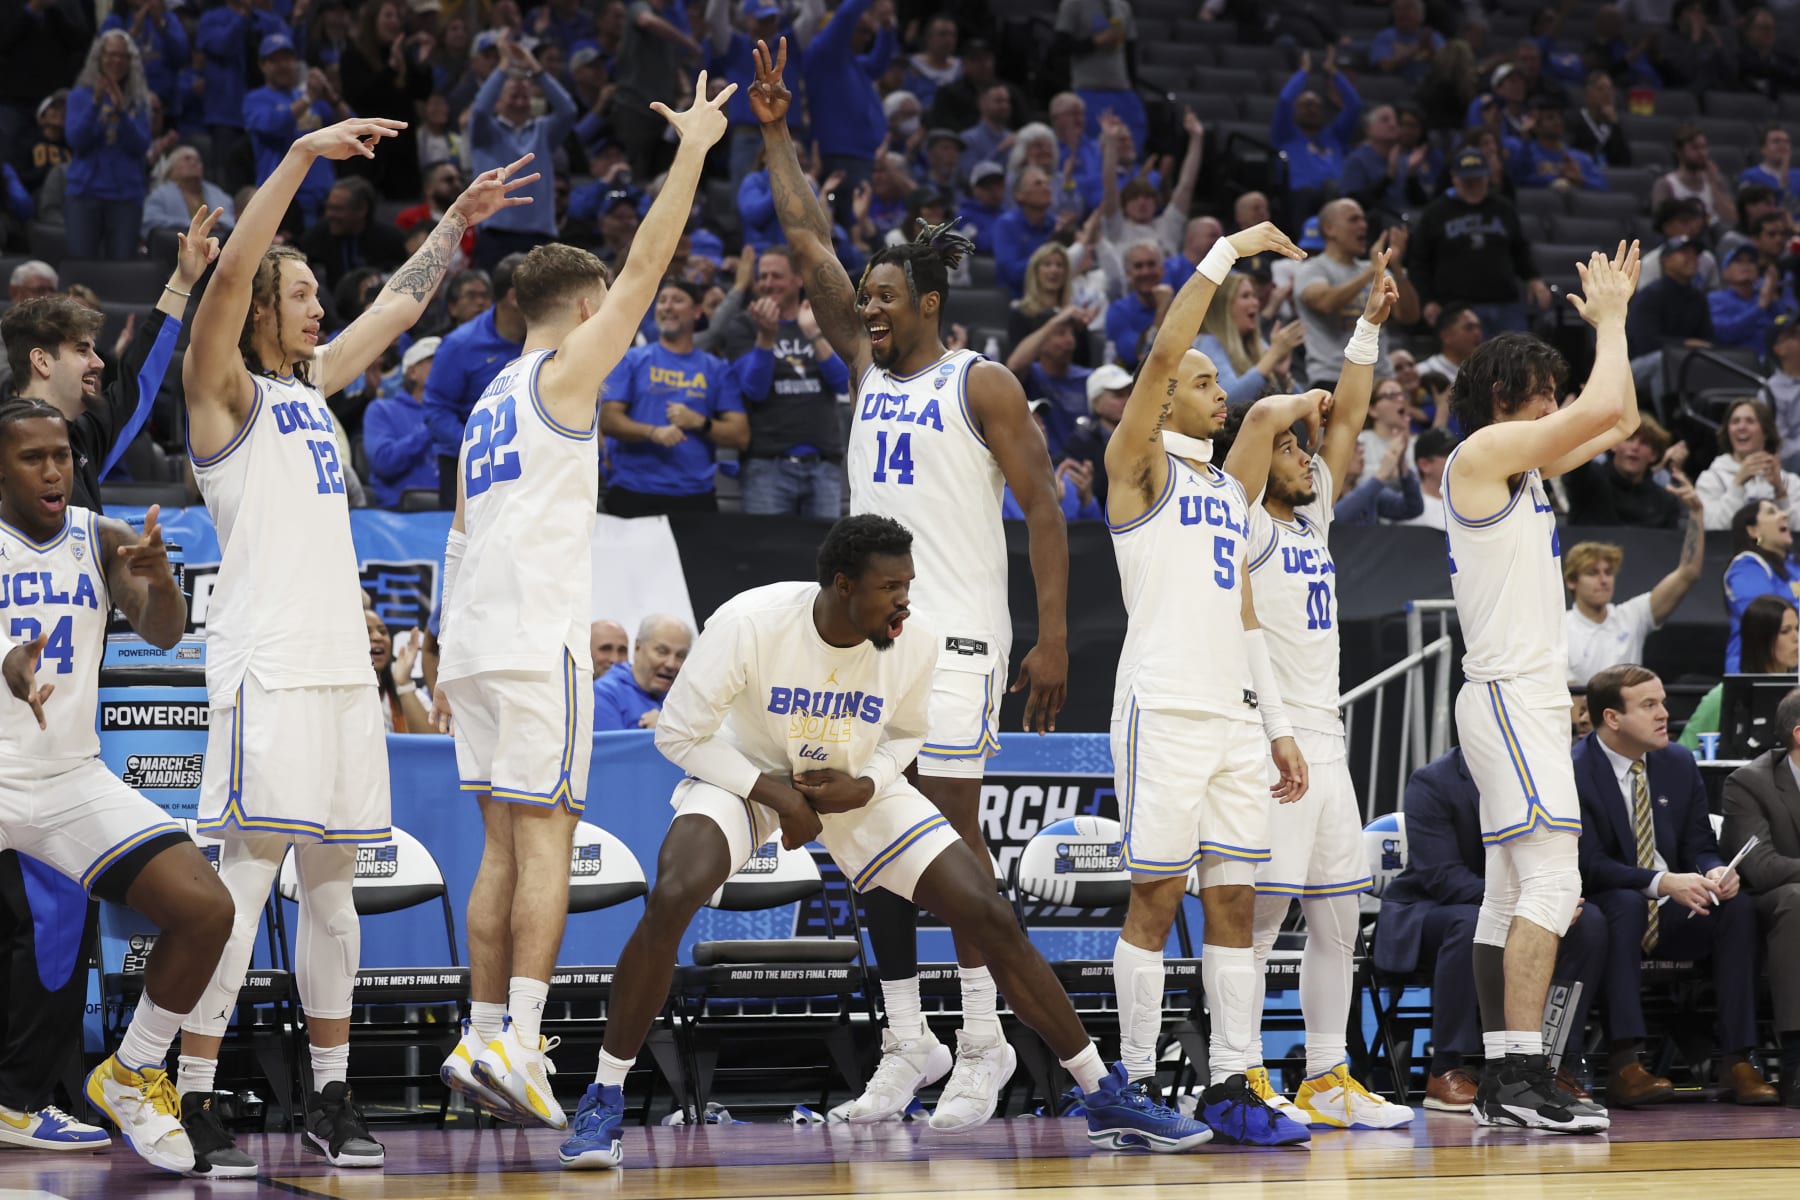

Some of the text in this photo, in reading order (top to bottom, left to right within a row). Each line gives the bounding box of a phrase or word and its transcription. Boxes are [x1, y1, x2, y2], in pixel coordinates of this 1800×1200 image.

[650, 365, 708, 390] UCLA
[861, 392, 944, 432] UCLA
[465, 394, 522, 500] 22
[873, 431, 914, 485] 14
[306, 440, 345, 494] 12
[1213, 535, 1235, 590] 5
[1306, 580, 1332, 630] 10
[118, 649, 168, 657] POWERADE
[767, 686, 884, 724] BRUINS
[104, 706, 210, 726] POWERAD
[788, 708, 853, 742] SOLE
[140, 757, 184, 771] MARCH
[144, 770, 202, 784] MADNESS
[979, 785, 1081, 840] RCH
[1068, 845, 1107, 857] MARCH
[571, 859, 600, 872] NESS
[1075, 857, 1119, 869] MADNES
[731, 969, 848, 980] ROAD TO THE MEN'S FINAL FOUR
[920, 970, 941, 979] ROAD
[942, 970, 952, 978] TO
[1081, 967, 1114, 976] ROAD TO
[1176, 966, 1196, 975] FOUR
[1270, 965, 1280, 974] TO
[1281, 965, 1295, 974] THE
[250, 977, 272, 987] FOUR
[362, 977, 372, 986] TO
[374, 976, 388, 986] THE
[390, 975, 415, 986] MEN'S
[416, 975, 438, 985] FINAL
[439, 974, 462, 984] FOUR
[573, 974, 583, 983] TO
[584, 973, 599, 983] THE
[86, 1003, 103, 1015] OF
